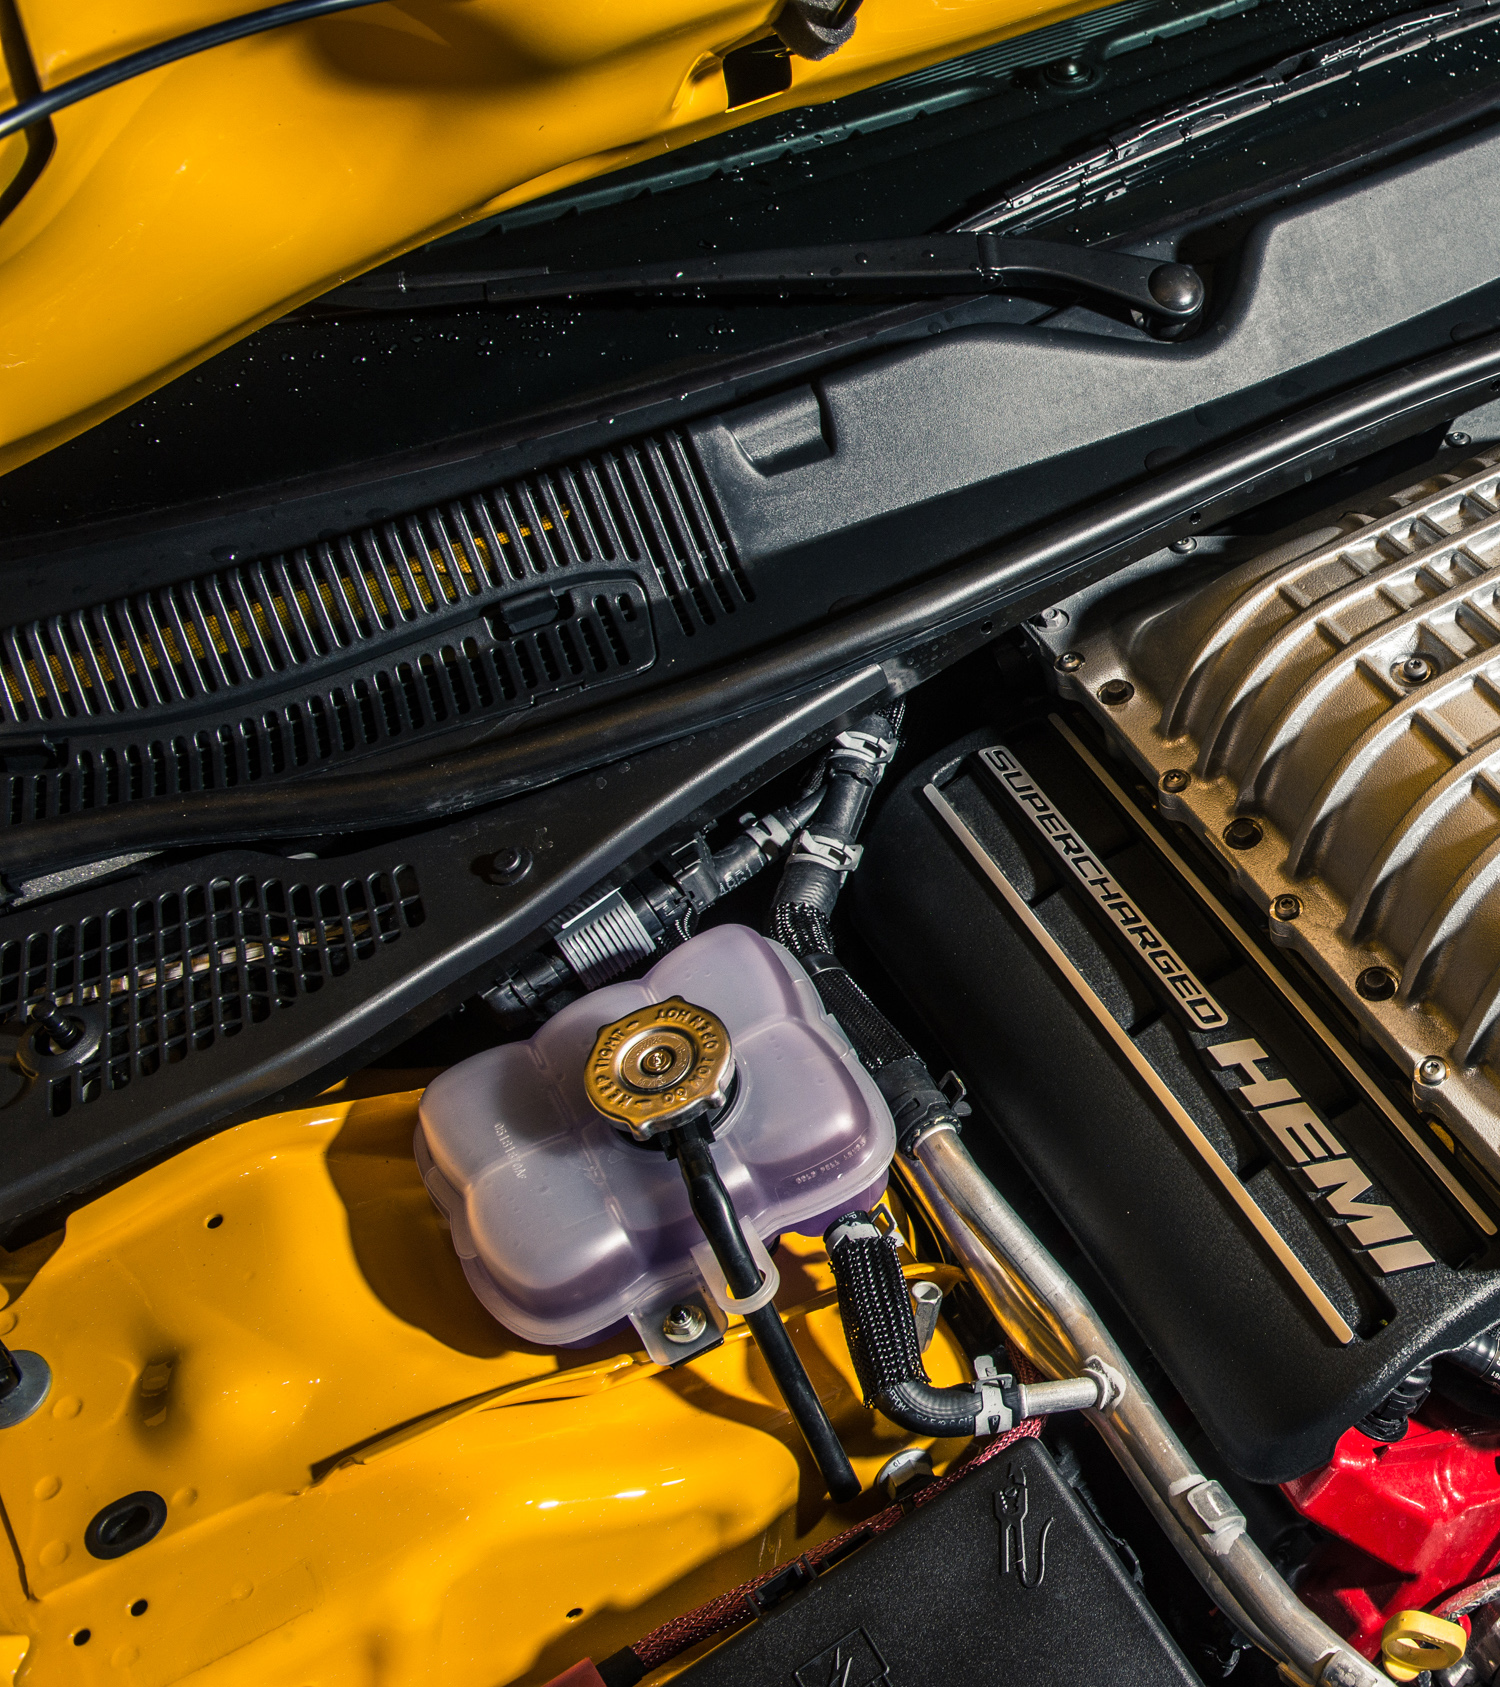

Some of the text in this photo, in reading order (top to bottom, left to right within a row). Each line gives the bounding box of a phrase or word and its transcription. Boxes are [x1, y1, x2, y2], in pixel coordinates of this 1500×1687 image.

[984, 748, 1225, 1027] SUPERCHARGED
[655, 1008, 692, 1023] HOT
[690, 1014, 719, 1052] OPEN
[595, 1027, 633, 1109] KEEP TIGHT
[1207, 1037, 1436, 1275] HEMI
